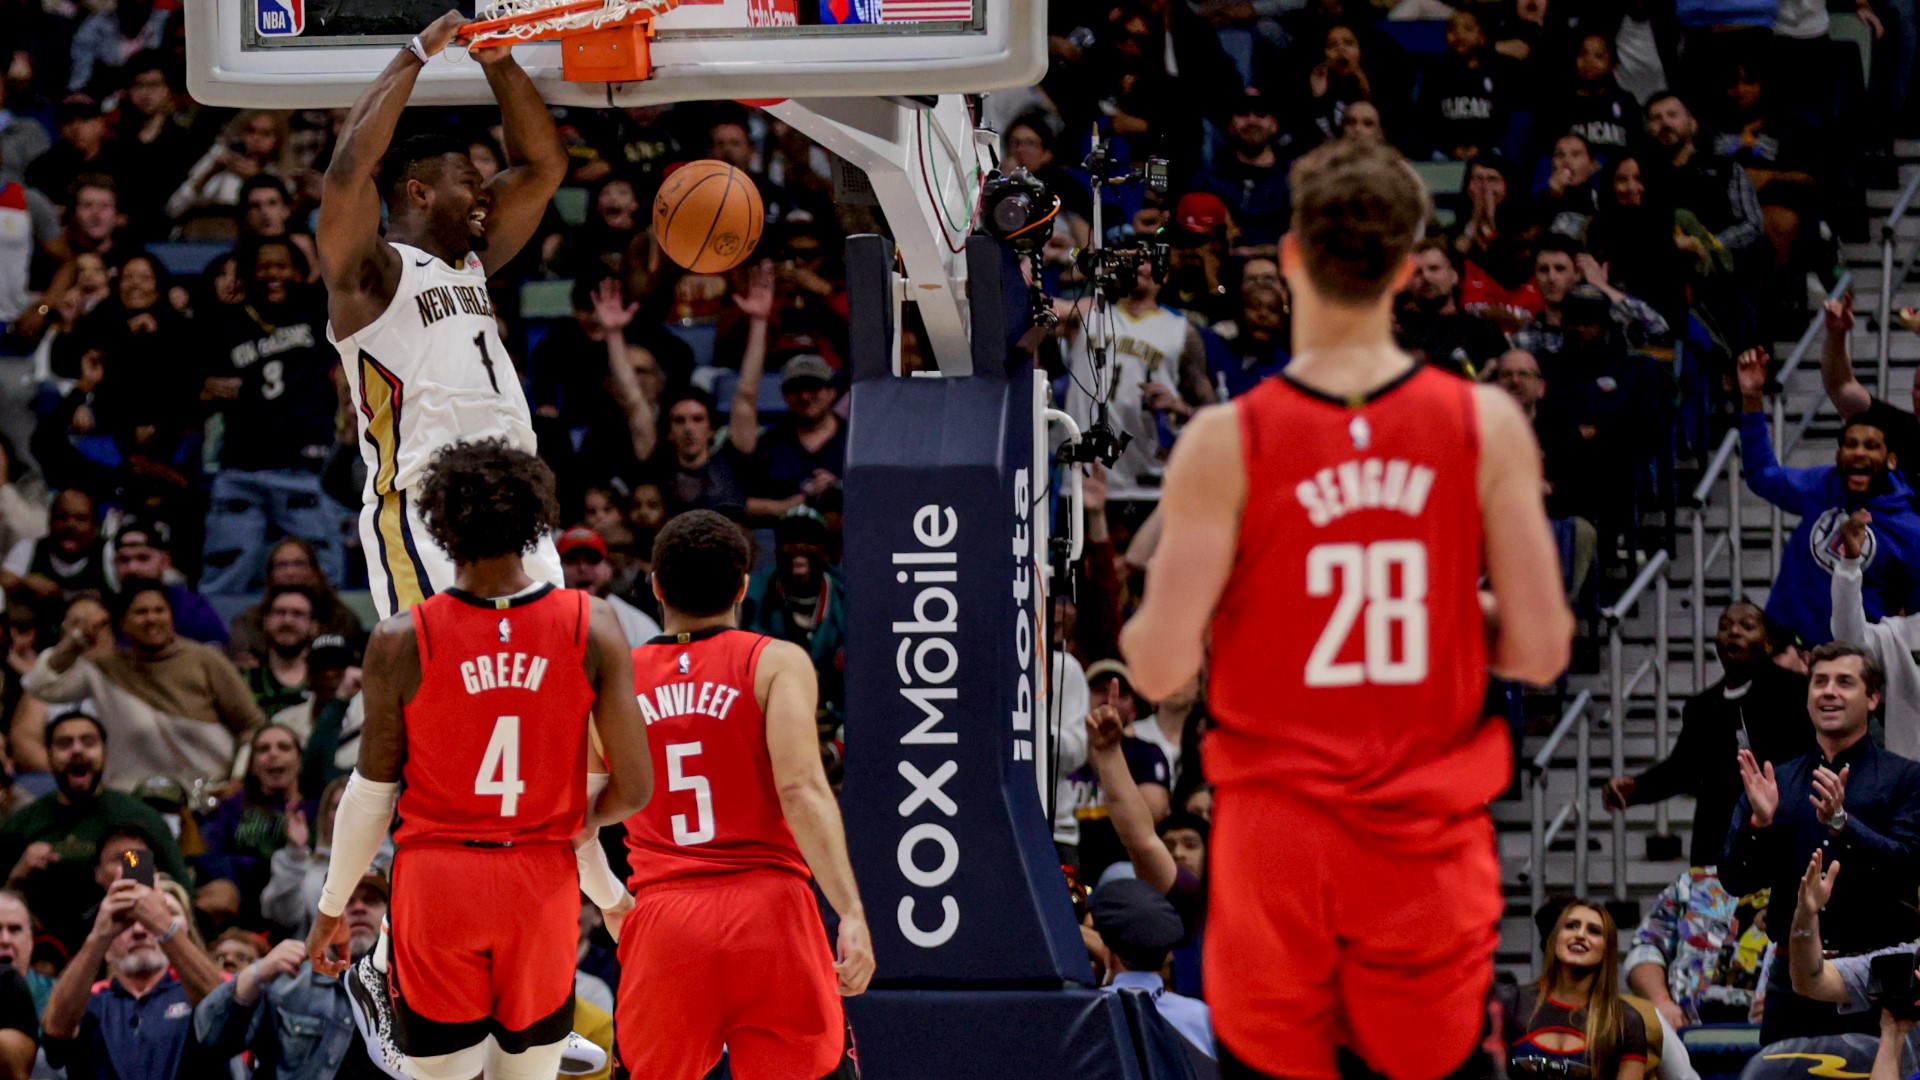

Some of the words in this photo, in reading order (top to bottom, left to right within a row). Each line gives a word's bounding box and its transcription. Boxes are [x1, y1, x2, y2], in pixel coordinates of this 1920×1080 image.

[262, 11, 287, 30] NBA
[414, 286, 457, 328] NEW
[452, 285, 495, 320] ORLE
[473, 330, 501, 395] 1
[1296, 457, 1435, 527] SENGUN
[892, 504, 958, 744] Mobile
[1012, 467, 1033, 761] ibotta
[1304, 539, 1429, 687] 28
[460, 652, 548, 695] GREEN
[636, 681, 740, 726] ANVLEET
[475, 716, 526, 817] 4
[665, 741, 715, 846] 5
